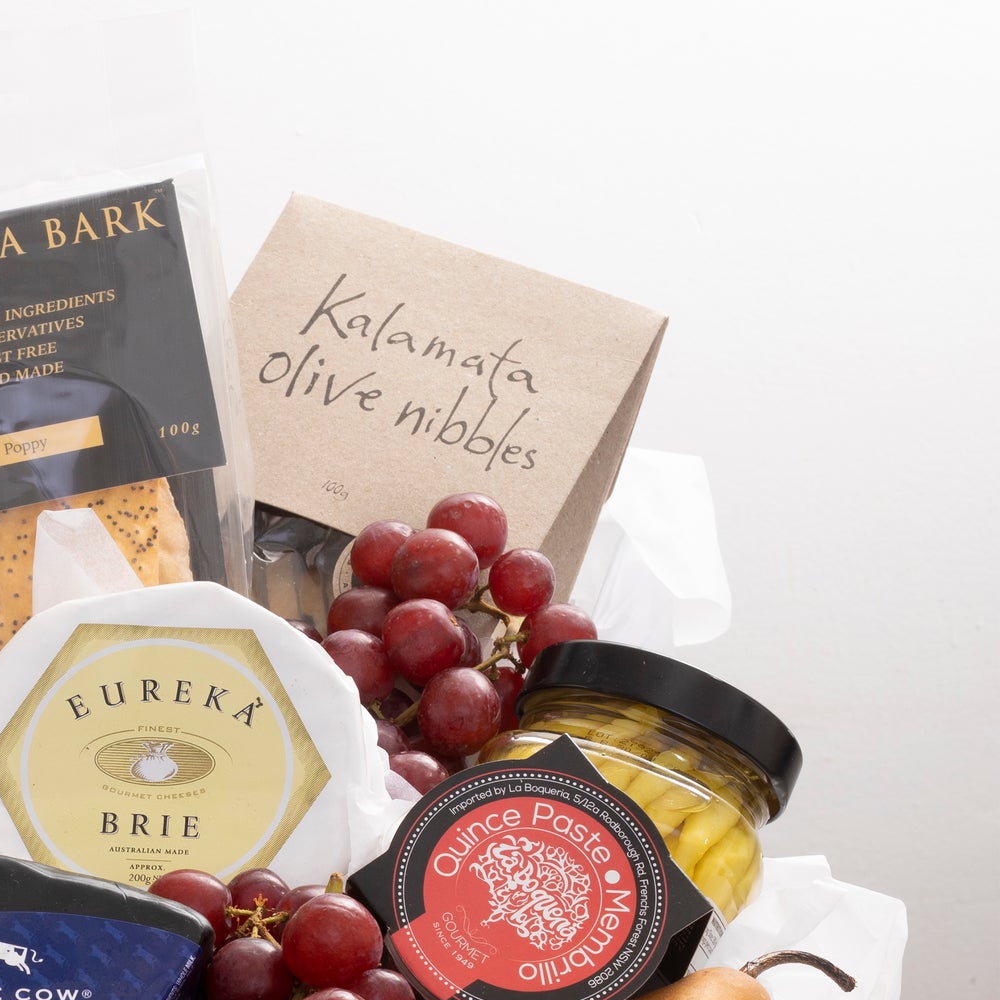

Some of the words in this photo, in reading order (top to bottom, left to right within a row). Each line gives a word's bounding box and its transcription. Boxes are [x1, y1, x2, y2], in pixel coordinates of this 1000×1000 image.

[42, 197, 166, 250] BARK
[4, 288, 116, 322] INGREDIENTS
[299, 273, 540, 400] Kalamata
[17, 341, 58, 361] FREE
[15, 361, 65, 383] MADE
[159, 421, 201, 439] 100g
[394, 385, 537, 473] nibbles
[3, 436, 48, 457] Poppy
[320, 479, 349, 502] 100g
[137, 725, 181, 734] FINEST
[102, 784, 152, 800] GOURMET
[156, 788, 207, 800] CHEESES
[493, 786, 507, 799] by
[508, 784, 522, 794] La
[524, 783, 572, 801] Boqueria,
[449, 789, 493, 815] Imported
[573, 795, 601, 815] 5/12a
[100, 811, 201, 840] BRIE
[600, 810, 640, 863] Rodborough
[109, 846, 162, 855] AUSTRALIAN
[164, 848, 190, 856] MADE
[433, 806, 522, 878] Quince
[532, 801, 612, 864] Paste
[128, 873, 152, 886] 200g
[636, 862, 647, 877] Rd,
[638, 878, 650, 916] Frenchs
[442, 911, 490, 966] GOURMET
[518, 888, 633, 986] Membrillo
[630, 916, 648, 949] Forest
[433, 921, 453, 950] SINCE
[452, 950, 475, 970] 1949
[612, 947, 635, 971] NSW
[588, 966, 615, 989] 2086
